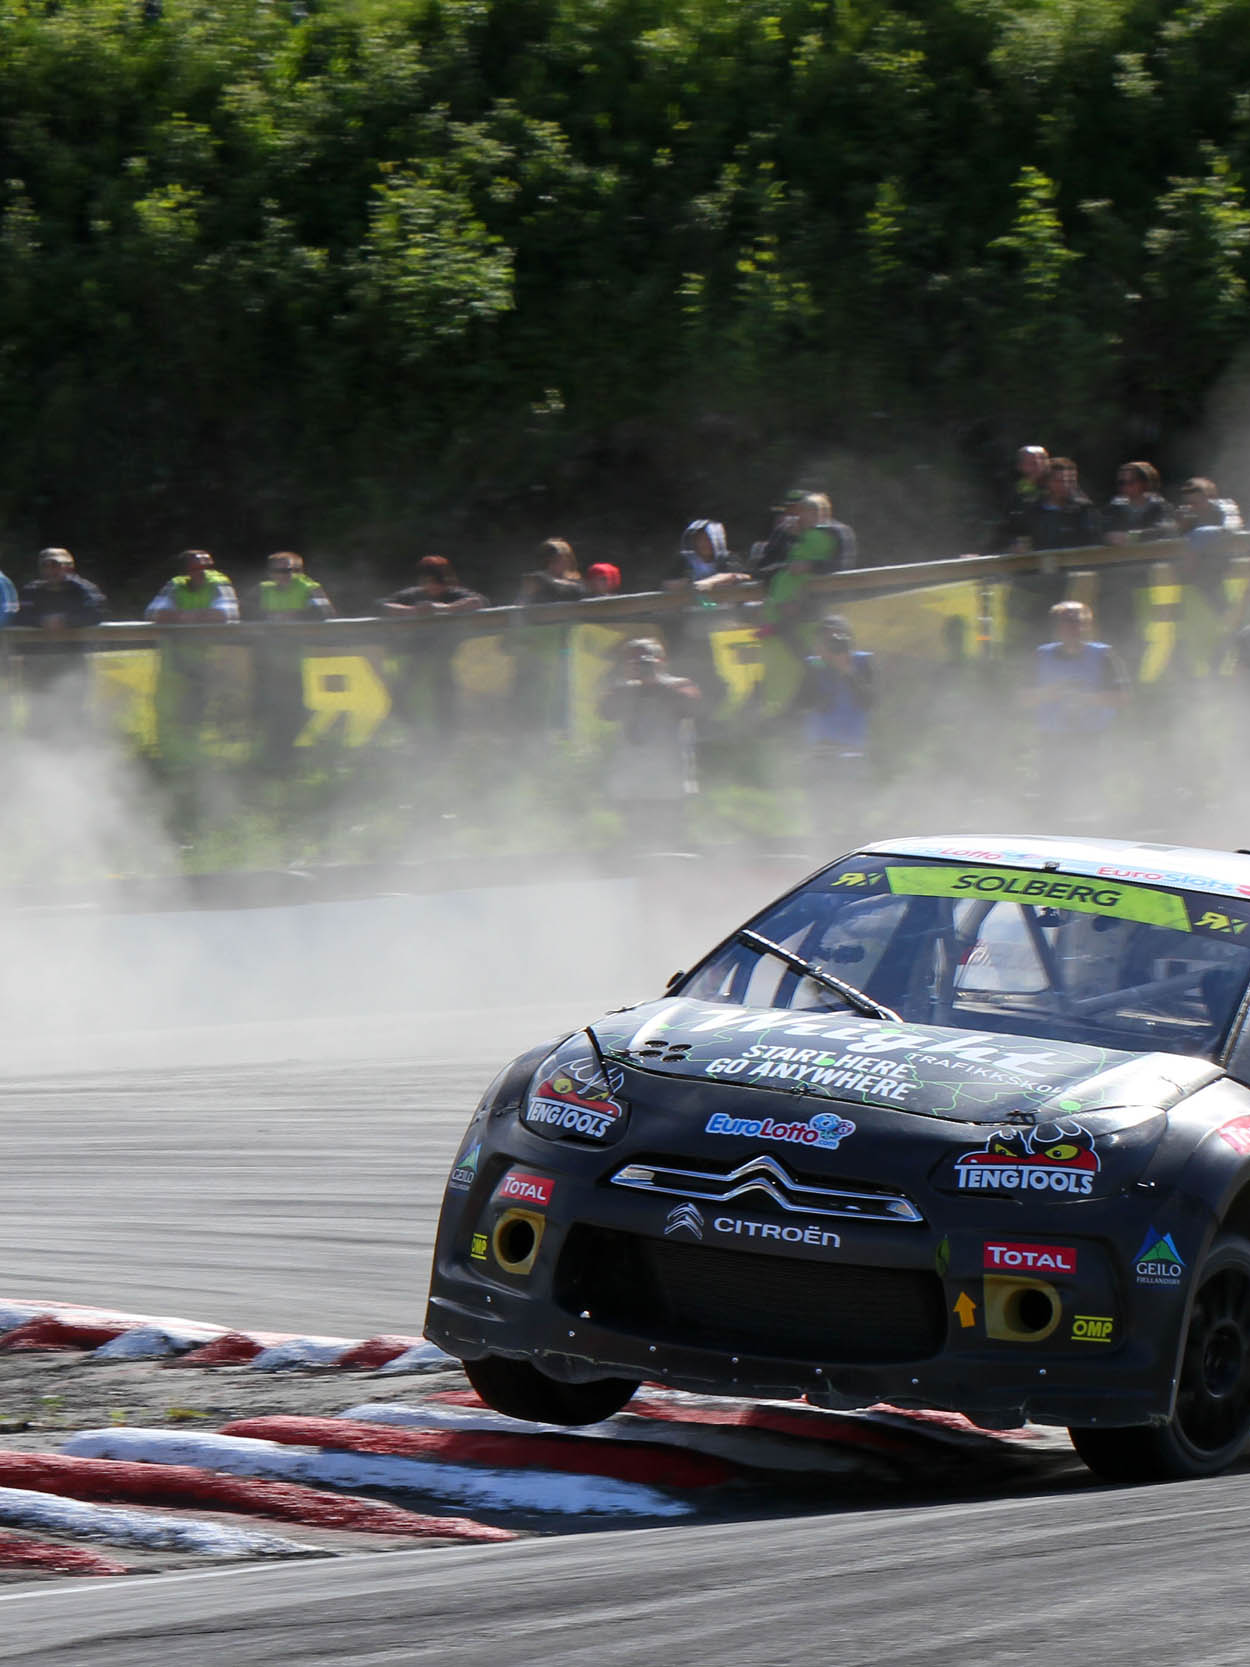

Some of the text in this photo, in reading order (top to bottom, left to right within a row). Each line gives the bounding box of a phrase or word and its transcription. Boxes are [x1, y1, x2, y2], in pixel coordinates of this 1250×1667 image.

[952, 873, 1122, 907] SOLBERG
[687, 1009, 1058, 1078] Wright
[742, 1044, 916, 1080] START HERE
[705, 1057, 919, 1101] GO ANYWHERE
[503, 1176, 547, 1201] TOTAL
[714, 1217, 841, 1248] CITROËN
[987, 1246, 1072, 1269] TOTAL
[1136, 1262, 1182, 1277] GEILO
[1072, 1319, 1113, 1338] OMP
